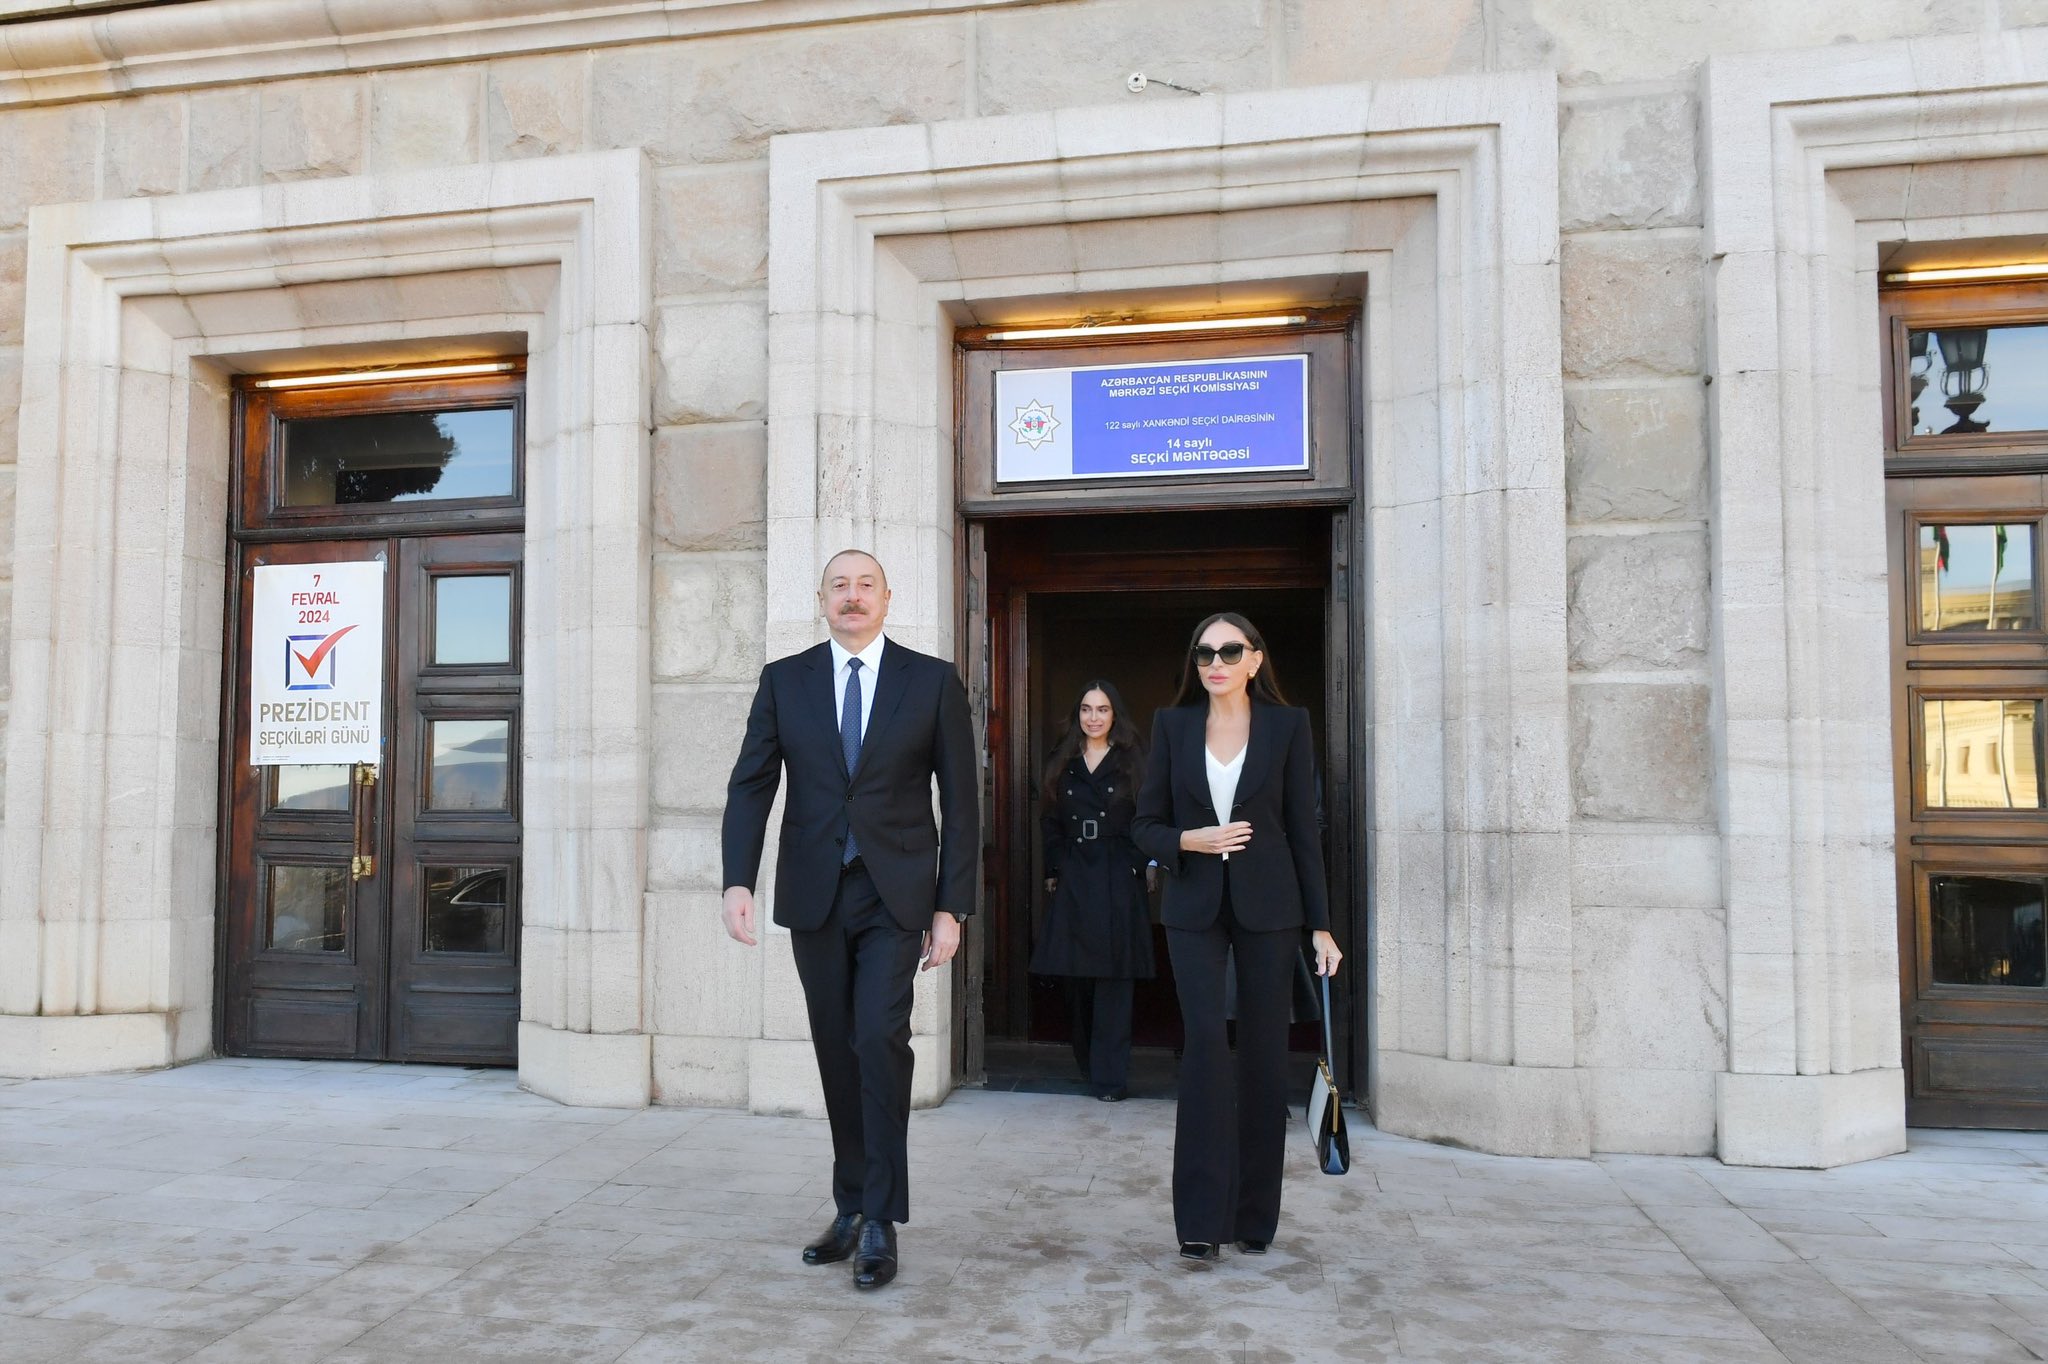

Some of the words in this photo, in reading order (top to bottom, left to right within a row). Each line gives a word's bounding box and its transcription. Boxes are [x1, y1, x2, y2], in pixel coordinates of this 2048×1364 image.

[1101, 376, 1170, 387] AZƏRBAYCAN
[1174, 370, 1268, 383] RESPUBLİKASININ
[1109, 386, 1156, 397] MƏRKƏZİ
[1159, 383, 1190, 396] SEÇKİ
[1193, 381, 1260, 393] KOMİSSİYASI
[1105, 421, 1120, 430] 122
[1122, 421, 1141, 430] saylı
[1142, 416, 1190, 428] XANKƏNDİ
[1192, 414, 1219, 427] SEÇKİ
[1221, 412, 1275, 424] DAİRƏSİNİN
[1167, 438, 1181, 449] 14
[1184, 437, 1213, 450] saylı
[1130, 450, 1169, 465] SEÇKİ
[1173, 446, 1250, 463] MƏNTƏQƏSİ
[313, 574, 321, 588] 7
[291, 591, 340, 606] FEVRAL
[298, 609, 331, 624] 2024
[259, 697, 371, 723] PREZİDENT
[259, 726, 327, 749] SEÇKİLƏRİ
[331, 725, 370, 744] GÜNÜ
